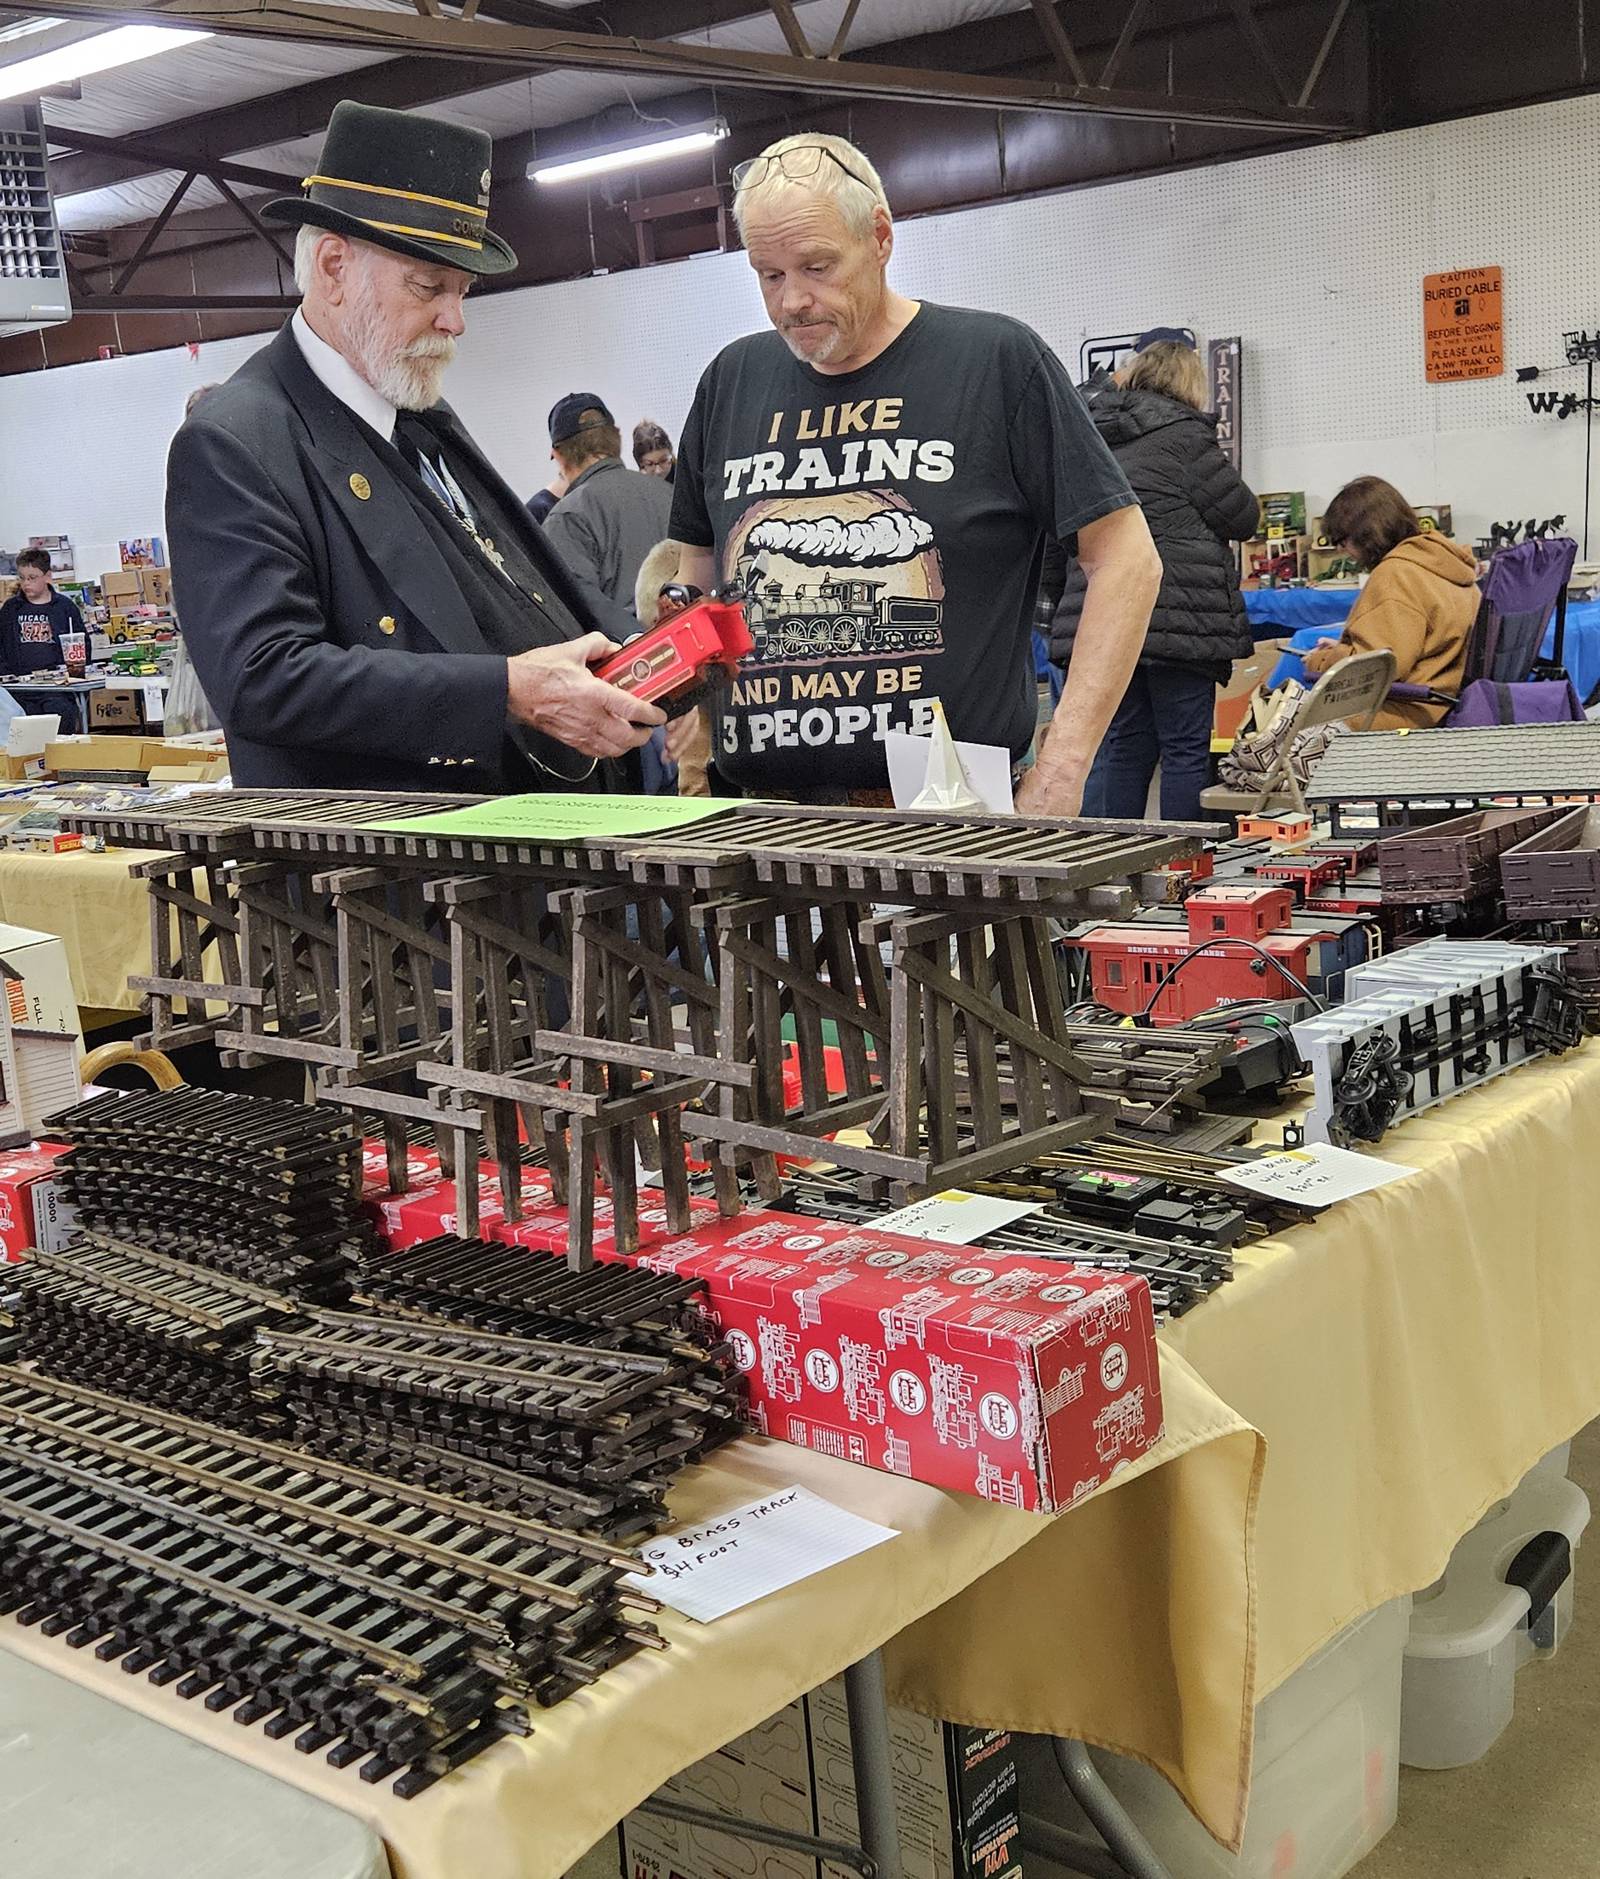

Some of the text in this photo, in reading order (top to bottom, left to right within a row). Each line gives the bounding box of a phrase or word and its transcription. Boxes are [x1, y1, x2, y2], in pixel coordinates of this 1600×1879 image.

[1440, 270, 1486, 283] CAUTION
[1425, 281, 1500, 301] BURIED CABLE
[1427, 322, 1500, 340] BEFORE DIGGING
[1432, 344, 1496, 360] PLEASE CALL
[1443, 361, 1455, 369] NW
[1468, 367, 1493, 376] DEPT.
[1526, 391, 1559, 414] W
[767, 397, 904, 443] I LIKE
[723, 438, 955, 500] TRAINS
[731, 665, 923, 706] AND MAY BE
[723, 696, 941, 754] 3 PEOPLE
[1127, 946, 1158, 954] DENVER
[1196, 949, 1226, 957] RANDE
[5, 979, 29, 1024] ORTABLE
[33, 996, 43, 1025] FULL
[47, 1191, 57, 1223] 10000
[648, 1492, 799, 1560] G BRASS TRACK
[697, 1539, 739, 1564] FOOT
